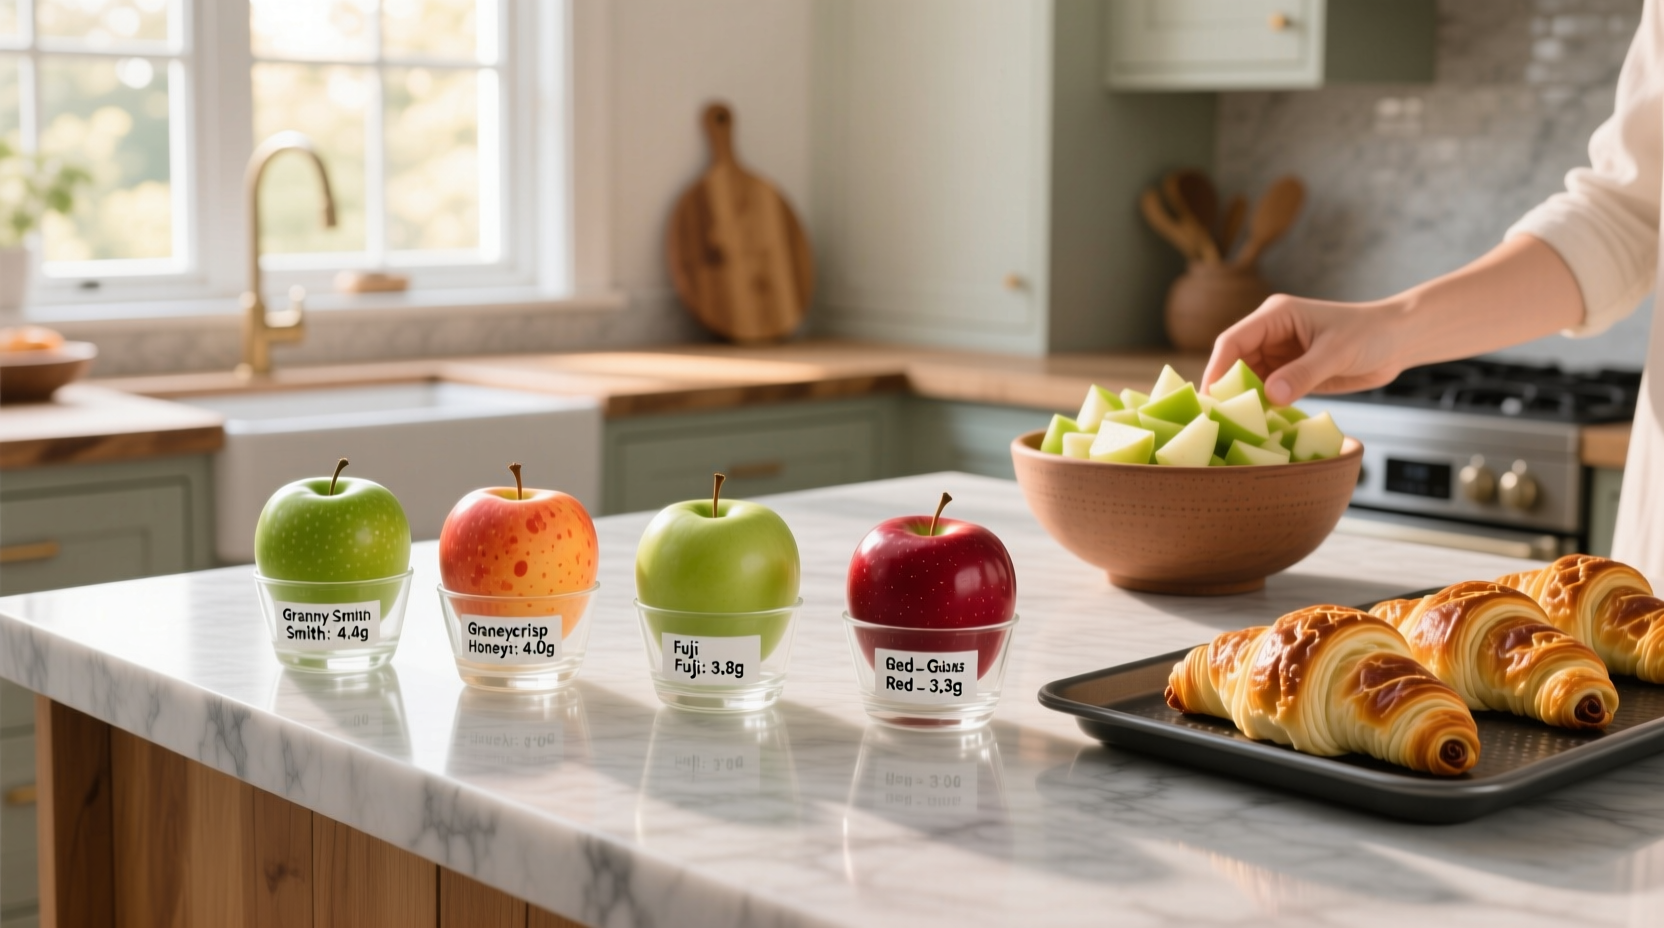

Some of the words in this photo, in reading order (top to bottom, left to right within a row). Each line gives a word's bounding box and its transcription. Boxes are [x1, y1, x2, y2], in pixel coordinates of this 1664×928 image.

[282, 608, 329, 626] Granny
[286, 625, 330, 640] Smith:
[337, 626, 369, 642] 4.4g
[522, 640, 555, 657] 4.0g
[674, 640, 699, 659] Fuji
[675, 658, 706, 679] Fuji:
[711, 660, 744, 679] 3.8g
[886, 676, 914, 692] Red
[929, 678, 963, 697] 3.3g
